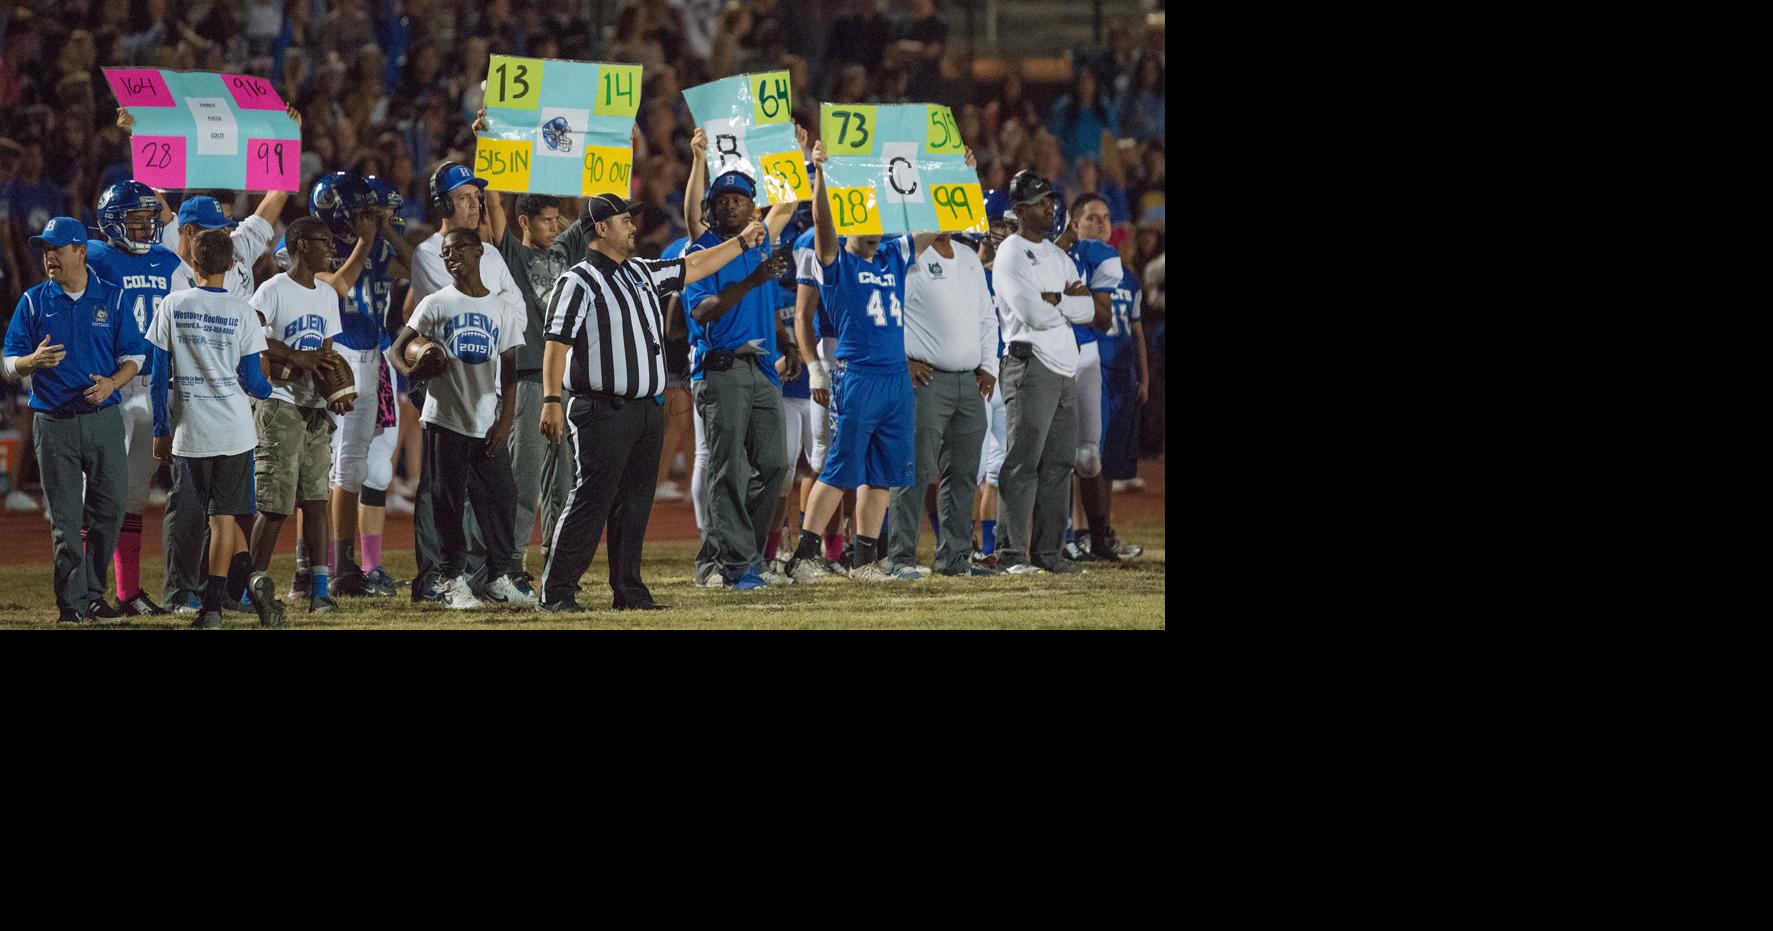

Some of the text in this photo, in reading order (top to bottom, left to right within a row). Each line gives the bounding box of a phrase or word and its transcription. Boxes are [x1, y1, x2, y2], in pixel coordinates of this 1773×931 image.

[119, 76, 157, 97] 164
[233, 77, 267, 99] 916
[495, 62, 530, 103] 13
[604, 71, 633, 107] 14
[758, 79, 791, 118] 64
[831, 110, 869, 148] 73
[142, 142, 172, 169] 28
[257, 142, 284, 176] 99
[476, 149, 529, 175] 515 IN
[584, 152, 631, 187] 90 OUT
[889, 156, 917, 195] C
[832, 190, 868, 228] 28
[933, 185, 974, 221] 99
[122, 275, 167, 290] COLTS
[173, 310, 239, 328] Westover Roofing LLC
[866, 288, 904, 328] 44
[459, 342, 488, 354] 2015
